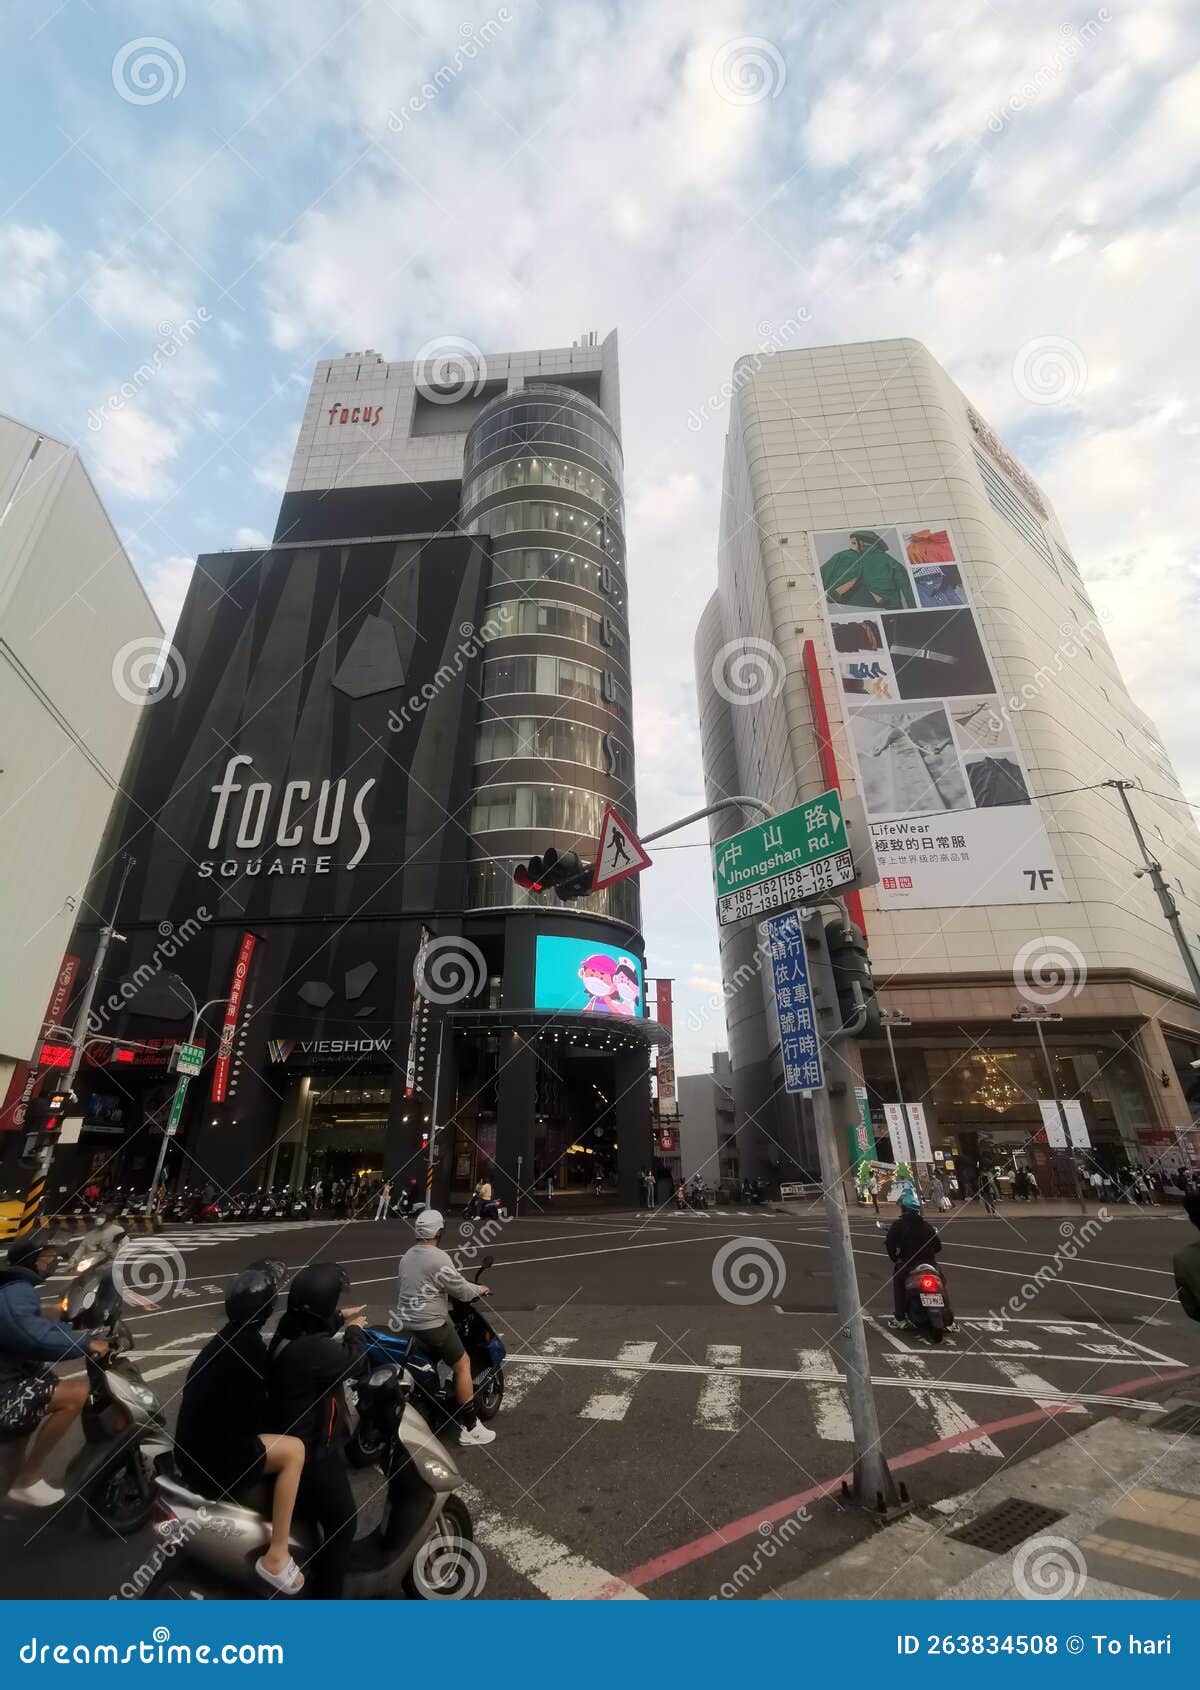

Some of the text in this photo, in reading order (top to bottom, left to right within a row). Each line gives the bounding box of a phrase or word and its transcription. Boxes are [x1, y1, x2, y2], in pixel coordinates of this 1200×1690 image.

[724, 804, 829, 866] 中山路
[871, 823, 931, 836] LifeWear
[875, 835, 967, 852] 極致的日常服
[198, 855, 332, 877] SQUARE
[727, 833, 834, 885] Jhongshan Rd.
[1023, 869, 1054, 891] 7F
[721, 856, 851, 914] 東 188-162 158-102 西
[736, 895, 778, 919] 207-139
[784, 875, 834, 901] 125-125
[771, 940, 803, 1087] 請依燈號行駛
[787, 935, 820, 1085] 行人專用時相
[301, 1039, 392, 1053] VIESHOW
